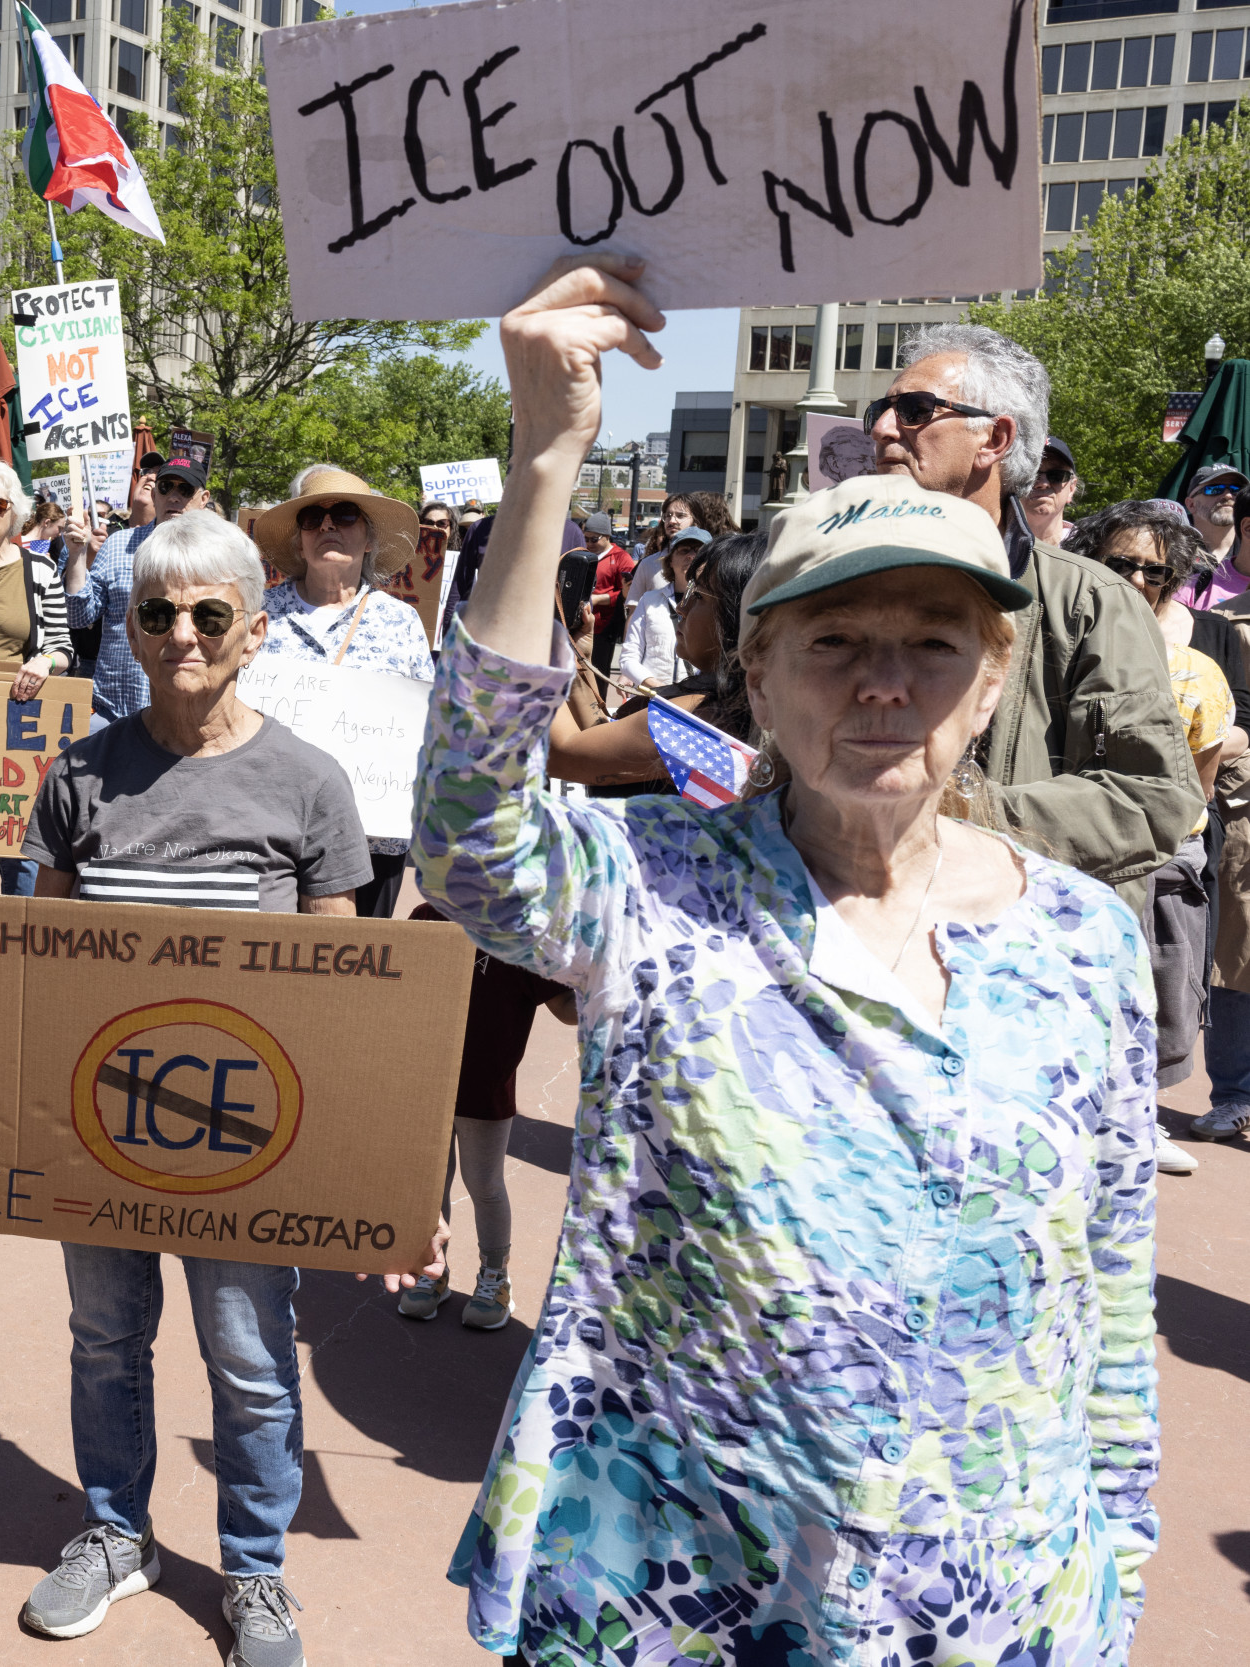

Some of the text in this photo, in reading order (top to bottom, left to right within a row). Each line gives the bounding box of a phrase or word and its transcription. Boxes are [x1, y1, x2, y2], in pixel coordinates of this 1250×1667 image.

[299, 0, 1026, 273] ICE OUT NOW
[15, 285, 115, 317] PROTECT
[18, 316, 120, 347] CIVILIANS
[47, 346, 99, 386] NOT
[29, 382, 99, 430] ICE
[45, 413, 129, 451] AGENTS
[50, 478, 66, 488] COME
[424, 475, 498, 492] SUPPORT
[446, 463, 471, 475] WE
[817, 499, 946, 534] Maine
[238, 670, 330, 691] WHY ARE
[259, 697, 405, 743] ICE Agents
[162, 841, 199, 860] Not
[0, 922, 142, 964] HUMANS
[149, 934, 226, 967] ARE
[240, 940, 403, 980] ILLEGAL
[113, 1048, 259, 1155] ICE
[88, 1199, 237, 1241] AMERICAN
[249, 1209, 396, 1250] GESTAPO
